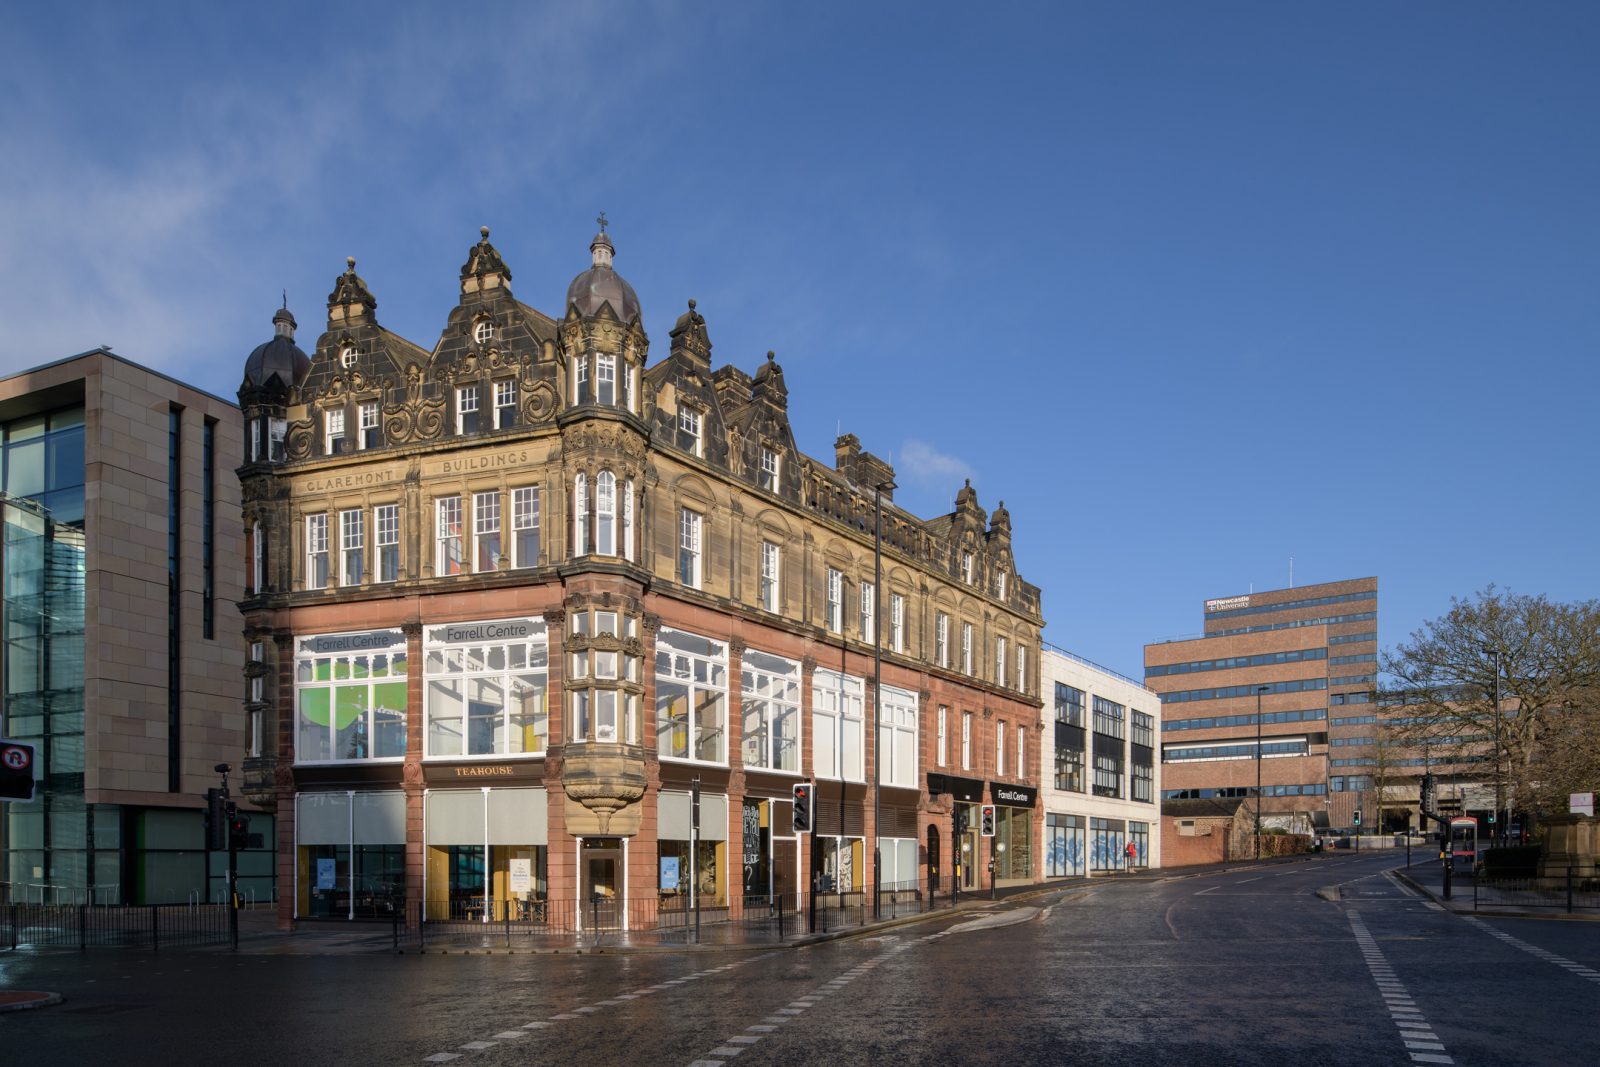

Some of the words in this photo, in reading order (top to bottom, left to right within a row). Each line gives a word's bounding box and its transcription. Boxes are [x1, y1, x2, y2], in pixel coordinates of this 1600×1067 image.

[443, 452, 527, 472] BUILDINGS
[306, 471, 392, 491] CLAREMONT
[1216, 596, 1250, 605] Newcastle
[1216, 602, 1250, 610] University
[447, 627, 484, 640] Farrell
[486, 625, 527, 638] Centre
[316, 638, 350, 651] Farrell
[352, 636, 389, 647] Centre
[455, 766, 514, 776] TEAHOUSE
[998, 789, 1013, 800] Farrell
[1013, 791, 1028, 802] Centre
